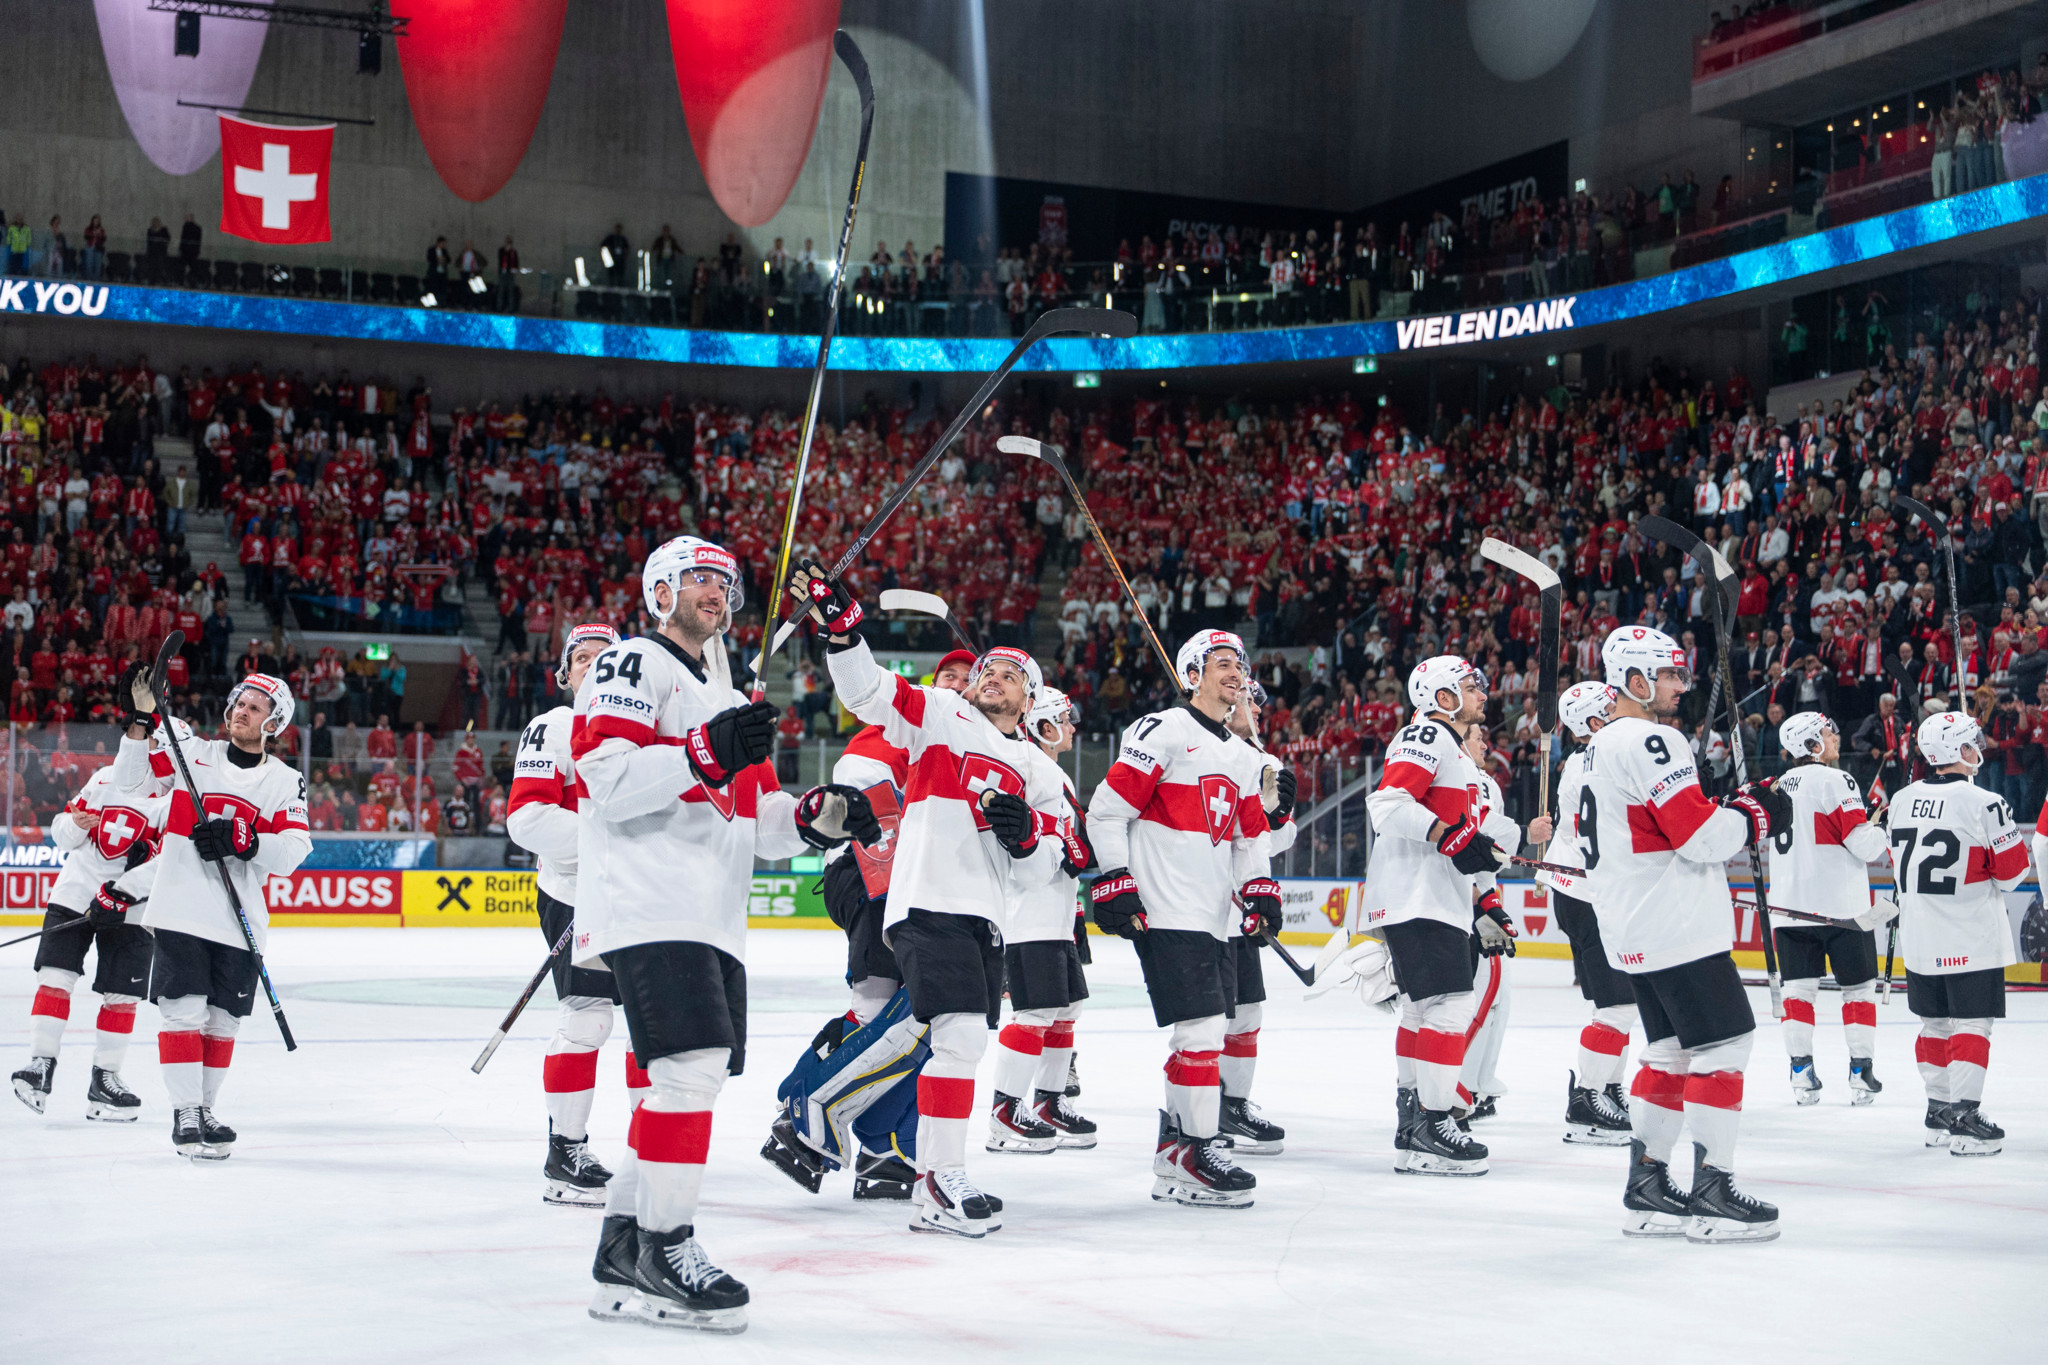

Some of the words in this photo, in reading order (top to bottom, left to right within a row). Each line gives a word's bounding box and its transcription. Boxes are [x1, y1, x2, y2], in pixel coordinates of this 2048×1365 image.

[1509, 176, 1537, 212] TO
[1167, 218, 1223, 241] PUCK
[0, 279, 29, 312] K
[33, 281, 109, 316] YOU
[1397, 309, 1498, 351] VIELEN
[1499, 296, 1577, 339] DANK
[599, 694, 654, 714] TISSOT
[521, 723, 548, 752] 94
[1401, 724, 1438, 745] 28
[1402, 747, 1438, 763] TISSOT
[1644, 734, 1671, 766] 9
[1928, 754, 1938, 763] 72
[1662, 766, 1696, 785] TISSOT
[1911, 799, 1944, 820] EGLI
[1986, 799, 2013, 827] 72
[1890, 827, 1961, 896] 72
[1554, 873, 1573, 888] IIHF
[269, 876, 394, 908] RAUSS
[485, 897, 535, 914] Bank
[1943, 956, 1969, 967] IIHF
